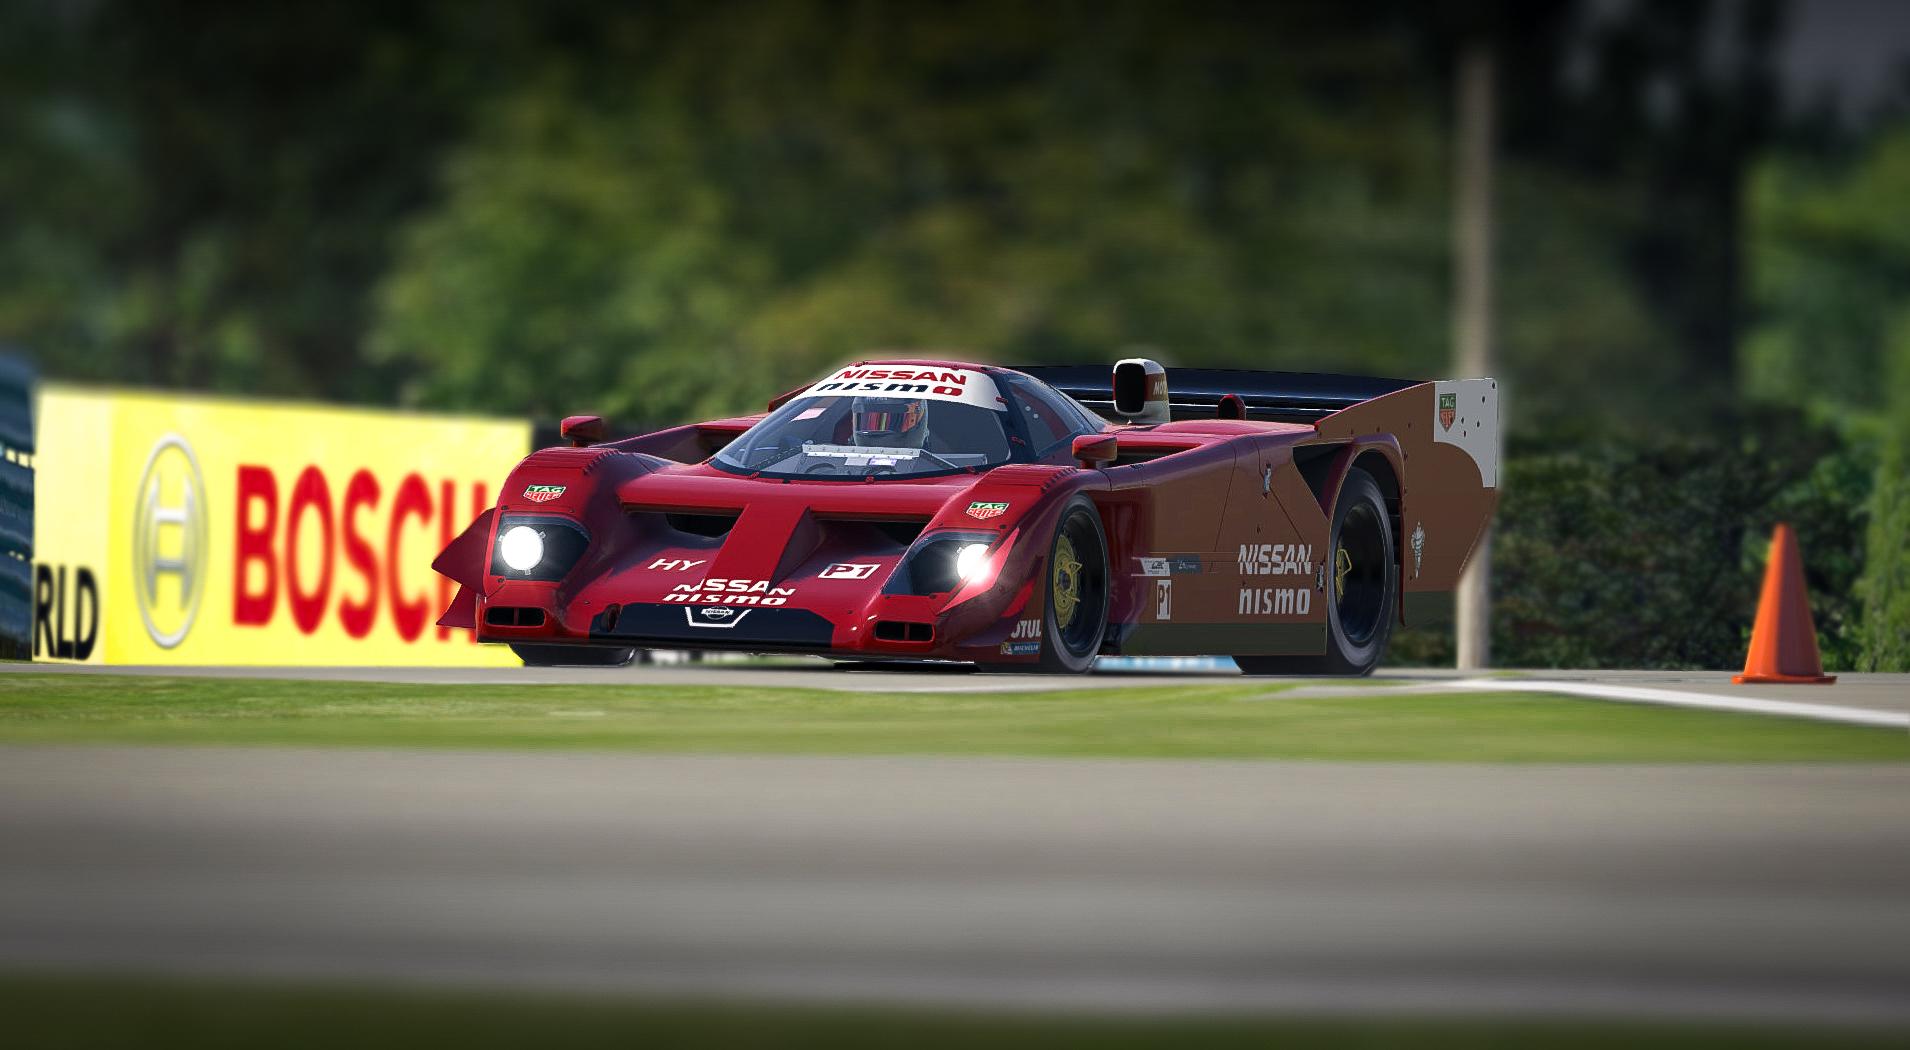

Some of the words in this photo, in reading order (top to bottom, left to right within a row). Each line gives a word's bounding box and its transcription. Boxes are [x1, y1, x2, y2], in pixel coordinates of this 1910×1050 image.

[834, 369, 967, 386] NISSAN
[816, 382, 963, 397] nismo
[1441, 397, 1455, 408] TAG
[647, 558, 707, 571] HY
[1238, 544, 1312, 575] NISSAN
[824, 565, 875, 577] P1
[1158, 584, 1170, 615] P1
[33, 563, 99, 661] RLD
